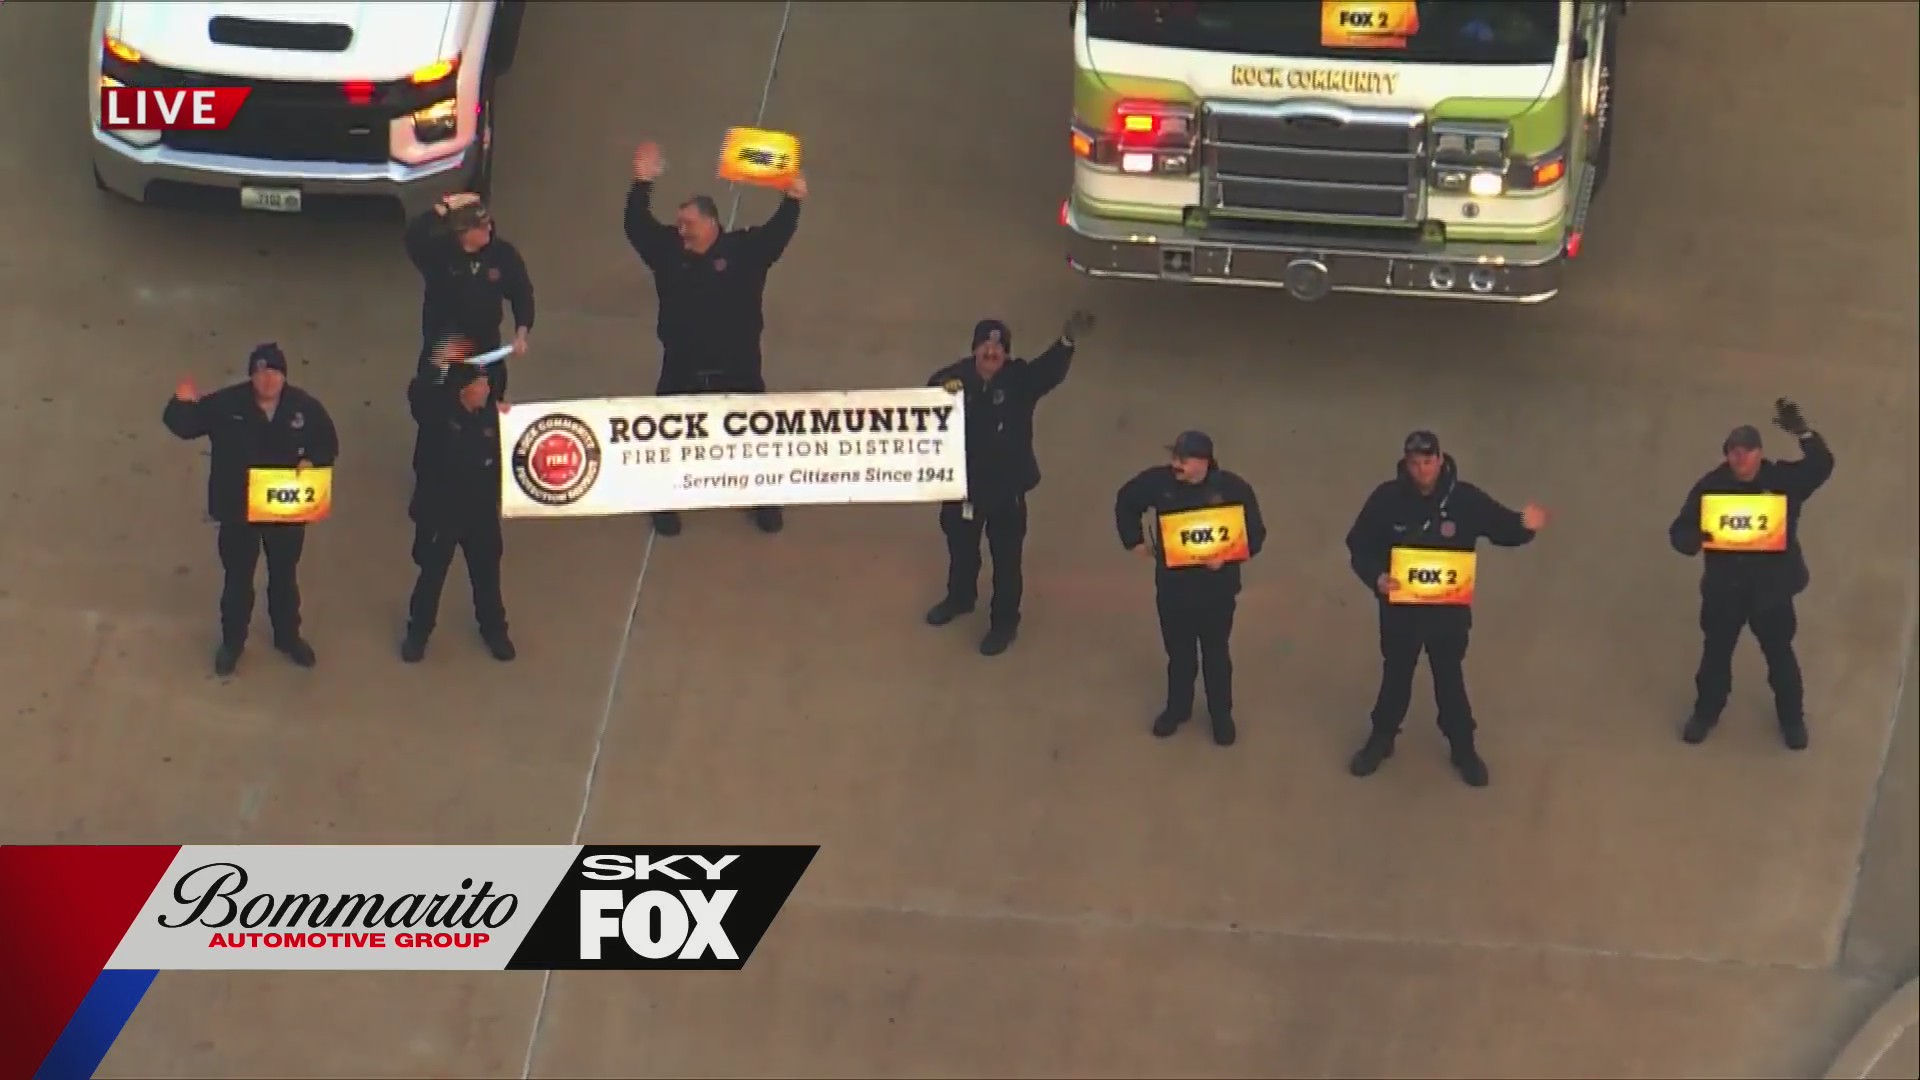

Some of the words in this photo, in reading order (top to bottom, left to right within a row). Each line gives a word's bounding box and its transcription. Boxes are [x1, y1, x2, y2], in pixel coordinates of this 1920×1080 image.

[1340, 12, 1373, 26] FOX
[1378, 14, 1388, 27] 2
[1231, 65, 1283, 88] ROCK
[1287, 68, 1398, 95] COMMUNITY
[609, 413, 709, 444] ROCK
[723, 406, 953, 437] COMMUNITY
[546, 453, 569, 467] FIRE
[622, 448, 671, 466] FIRE
[681, 441, 828, 461] PROTECTION
[839, 438, 943, 457] DISTRICT
[754, 474, 784, 487] our
[790, 468, 860, 485] Citizens
[866, 467, 912, 482] Since
[917, 467, 954, 483] 1941
[267, 487, 300, 504] FOX
[304, 486, 315, 503] 2
[1719, 514, 1753, 531] FOX
[1757, 513, 1768, 531] 2
[1180, 527, 1214, 547] FOX
[1218, 525, 1230, 542] 2
[1408, 567, 1441, 584] FOX
[1446, 569, 1457, 584] 2
